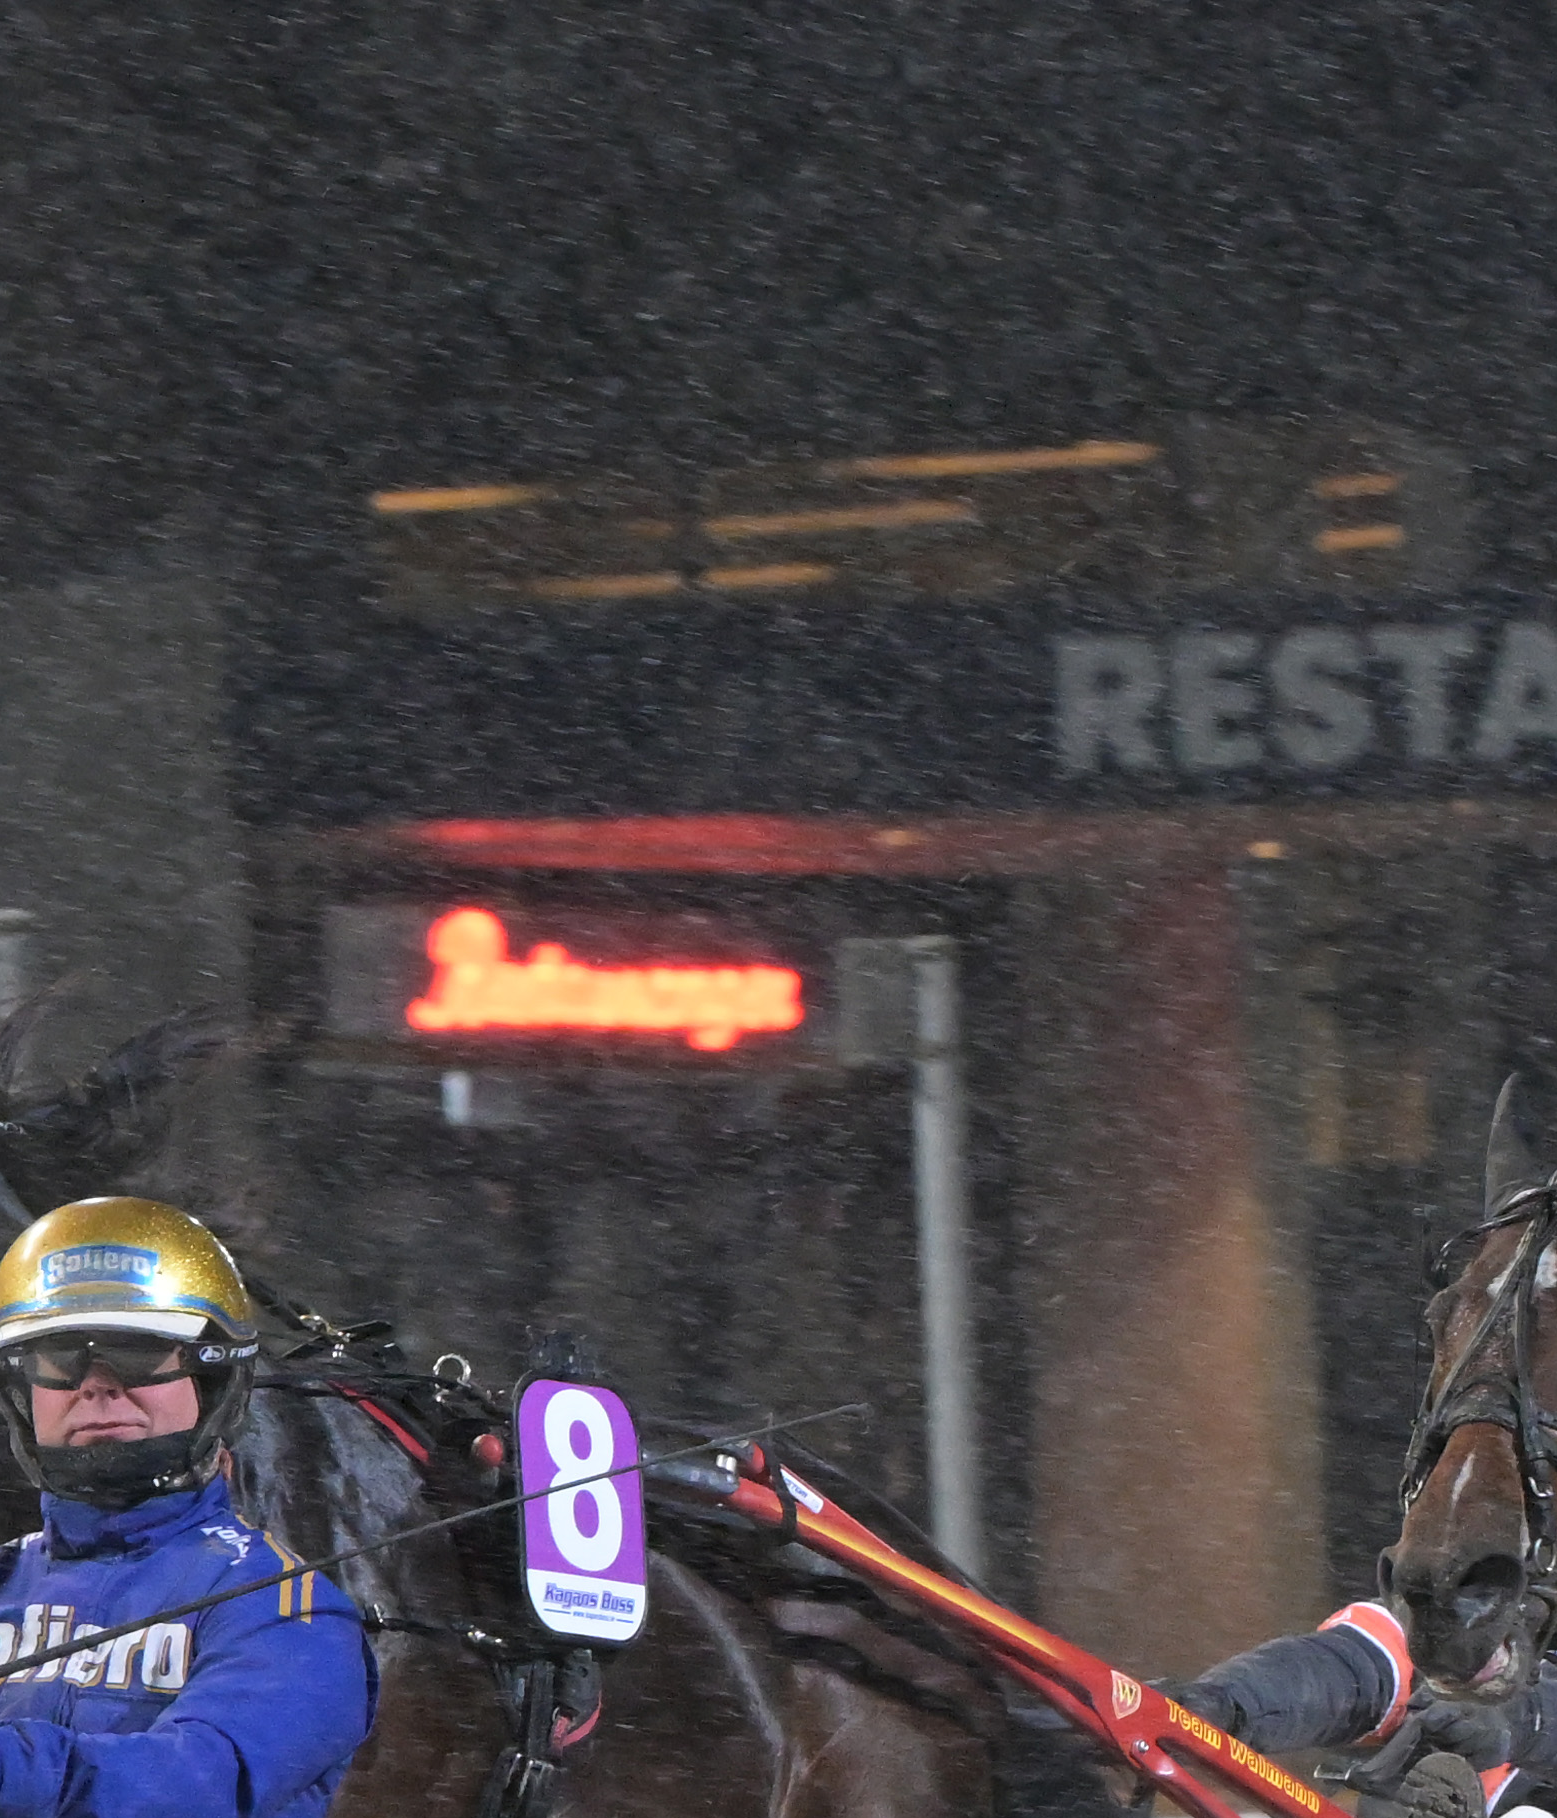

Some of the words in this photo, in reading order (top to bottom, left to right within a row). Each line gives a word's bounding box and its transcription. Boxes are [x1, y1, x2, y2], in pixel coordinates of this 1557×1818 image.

[544, 1389, 623, 1572] 8
[543, 1582, 599, 1609] Kagans
[600, 1590, 636, 1614] Buss
[1165, 1697, 1221, 1750] Team
